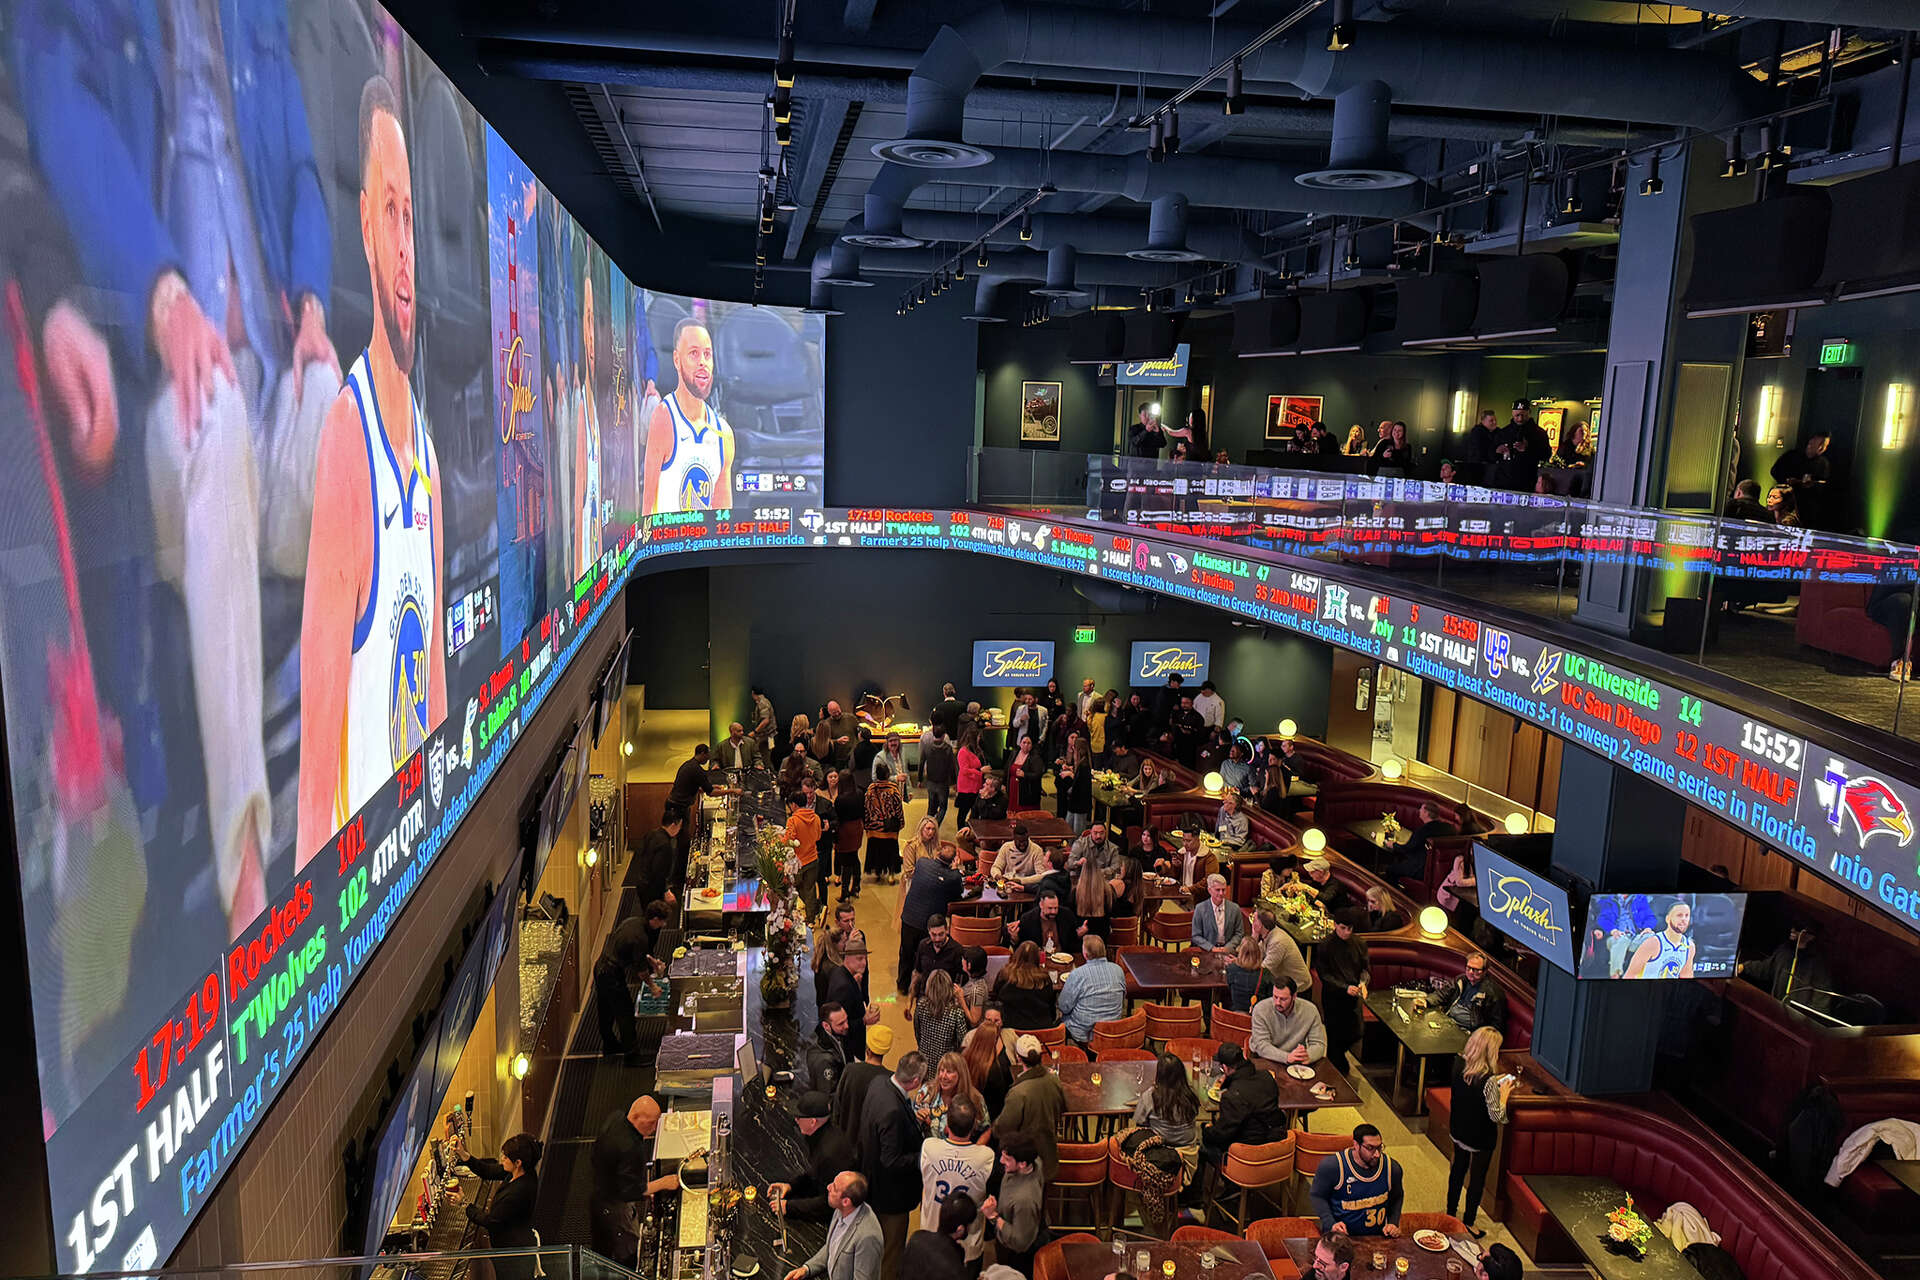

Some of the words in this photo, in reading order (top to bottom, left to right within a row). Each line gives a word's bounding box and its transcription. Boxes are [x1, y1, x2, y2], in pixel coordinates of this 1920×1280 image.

[1825, 346, 1842, 362] EXIT
[698, 480, 709, 498] 30
[652, 512, 662, 526] UC
[663, 510, 704, 526] Riverside
[715, 509, 730, 521] 14
[754, 508, 790, 521] 15:52
[825, 521, 847, 534] 1ST
[850, 521, 882, 534] HALF
[848, 509, 882, 521] 17:19
[886, 510, 934, 522] Rockets
[951, 512, 970, 524] 101
[987, 516, 1004, 528] 7:18
[652, 528, 663, 541] UC
[664, 526, 678, 540] San
[680, 525, 708, 540] Diego
[716, 524, 730, 534] 12
[734, 523, 755, 534] 1ST
[757, 522, 790, 534] HALF
[661, 541, 684, 557] sweep
[685, 538, 718, 552] 2-game
[720, 535, 750, 547] series
[753, 535, 762, 546] in
[766, 533, 805, 546] Florida
[886, 523, 940, 535] T'Wolves
[950, 525, 969, 537] 102
[972, 526, 986, 540] 4TH
[987, 528, 1004, 543] QTR
[1052, 526, 1063, 540] St.
[1064, 528, 1094, 545] Thomas
[860, 535, 909, 547] Farmer's
[910, 536, 923, 547] 25
[926, 536, 949, 549] help
[952, 538, 997, 555] Youngstown
[997, 545, 1015, 558] State
[1015, 548, 1037, 562] defeat
[1037, 551, 1065, 568] Oakland
[1066, 559, 1085, 572] 84-75
[1051, 540, 1060, 553] S.
[1060, 541, 1086, 559] Dakota
[1088, 547, 1097, 561] St
[1110, 550, 1131, 567] HALF
[1192, 551, 1232, 576] Arkansas
[1232, 560, 1250, 579] L.R.
[1256, 564, 1271, 582] 47
[1191, 569, 1200, 583] S.
[1201, 571, 1235, 593] Indiana
[1290, 572, 1319, 595] 14:57
[1108, 568, 1131, 583] scores
[1131, 571, 1143, 585] his
[1143, 574, 1164, 591] 879th
[1165, 580, 1173, 592] to
[1174, 583, 1196, 598] move
[1197, 586, 1220, 604] closer
[1221, 592, 1229, 606] to
[1230, 596, 1269, 622] Gretzky's
[1270, 607, 1300, 630] record,
[1301, 619, 1312, 632] as
[1312, 619, 1349, 646] Capitals
[1350, 630, 1372, 653] beat
[1270, 586, 1291, 607] 2ND
[1292, 591, 1317, 614] HALF
[1350, 604, 1365, 621] vs.
[1410, 604, 1420, 624] 5
[1442, 613, 1478, 641] 15:58
[1401, 626, 1417, 647] 11
[1419, 631, 1442, 655] 1ST
[1443, 640, 1476, 666] HALF
[983, 647, 1048, 678] Splash
[1141, 647, 1203, 678] Splash
[1511, 655, 1530, 678] vs.
[412, 649, 425, 706] 30
[1564, 653, 1585, 681] UC
[1587, 661, 1660, 711] Riverside
[1678, 695, 1702, 728] 14
[1406, 650, 1455, 688] Lightning
[1457, 669, 1483, 696] beat
[1484, 680, 1536, 720] Senators
[1538, 702, 1557, 726] 5-1
[1560, 710, 1574, 733] to
[1575, 719, 1618, 760] sweep
[1620, 738, 1675, 784] 2-game
[1677, 767, 1726, 810] series
[1729, 790, 1747, 821] in
[1750, 799, 1817, 860] Florida
[1561, 681, 1583, 706] UC
[1584, 687, 1614, 720] San
[1615, 702, 1662, 745] Diego
[1674, 729, 1698, 762] 12
[1702, 741, 1740, 780] 1ST
[1740, 760, 1798, 807] HALF
[1740, 721, 1800, 772] 15:52
[445, 743, 459, 776] vs.
[397, 751, 422, 808] 7:18
[337, 814, 367, 878] 101
[338, 865, 369, 933] 102
[371, 824, 397, 885] 4TH
[400, 798, 425, 857] QTR
[1489, 876, 1563, 932] Splash
[228, 879, 313, 1003] Rockets
[180, 1046, 281, 1216] Farmer's
[283, 1005, 305, 1068] 25
[307, 961, 343, 1032] help
[344, 864, 418, 977] Youngstown
[417, 822, 442, 873] State
[442, 791, 468, 838] defeat
[468, 752, 494, 799] Oakland
[231, 924, 327, 1065] T'Wolves
[133, 972, 220, 1114] 17:19
[66, 1144, 139, 1276] 1ST
[146, 1040, 225, 1183] HALF
[931, 1158, 977, 1182] LOONEY
[1364, 1207, 1386, 1228] 30
